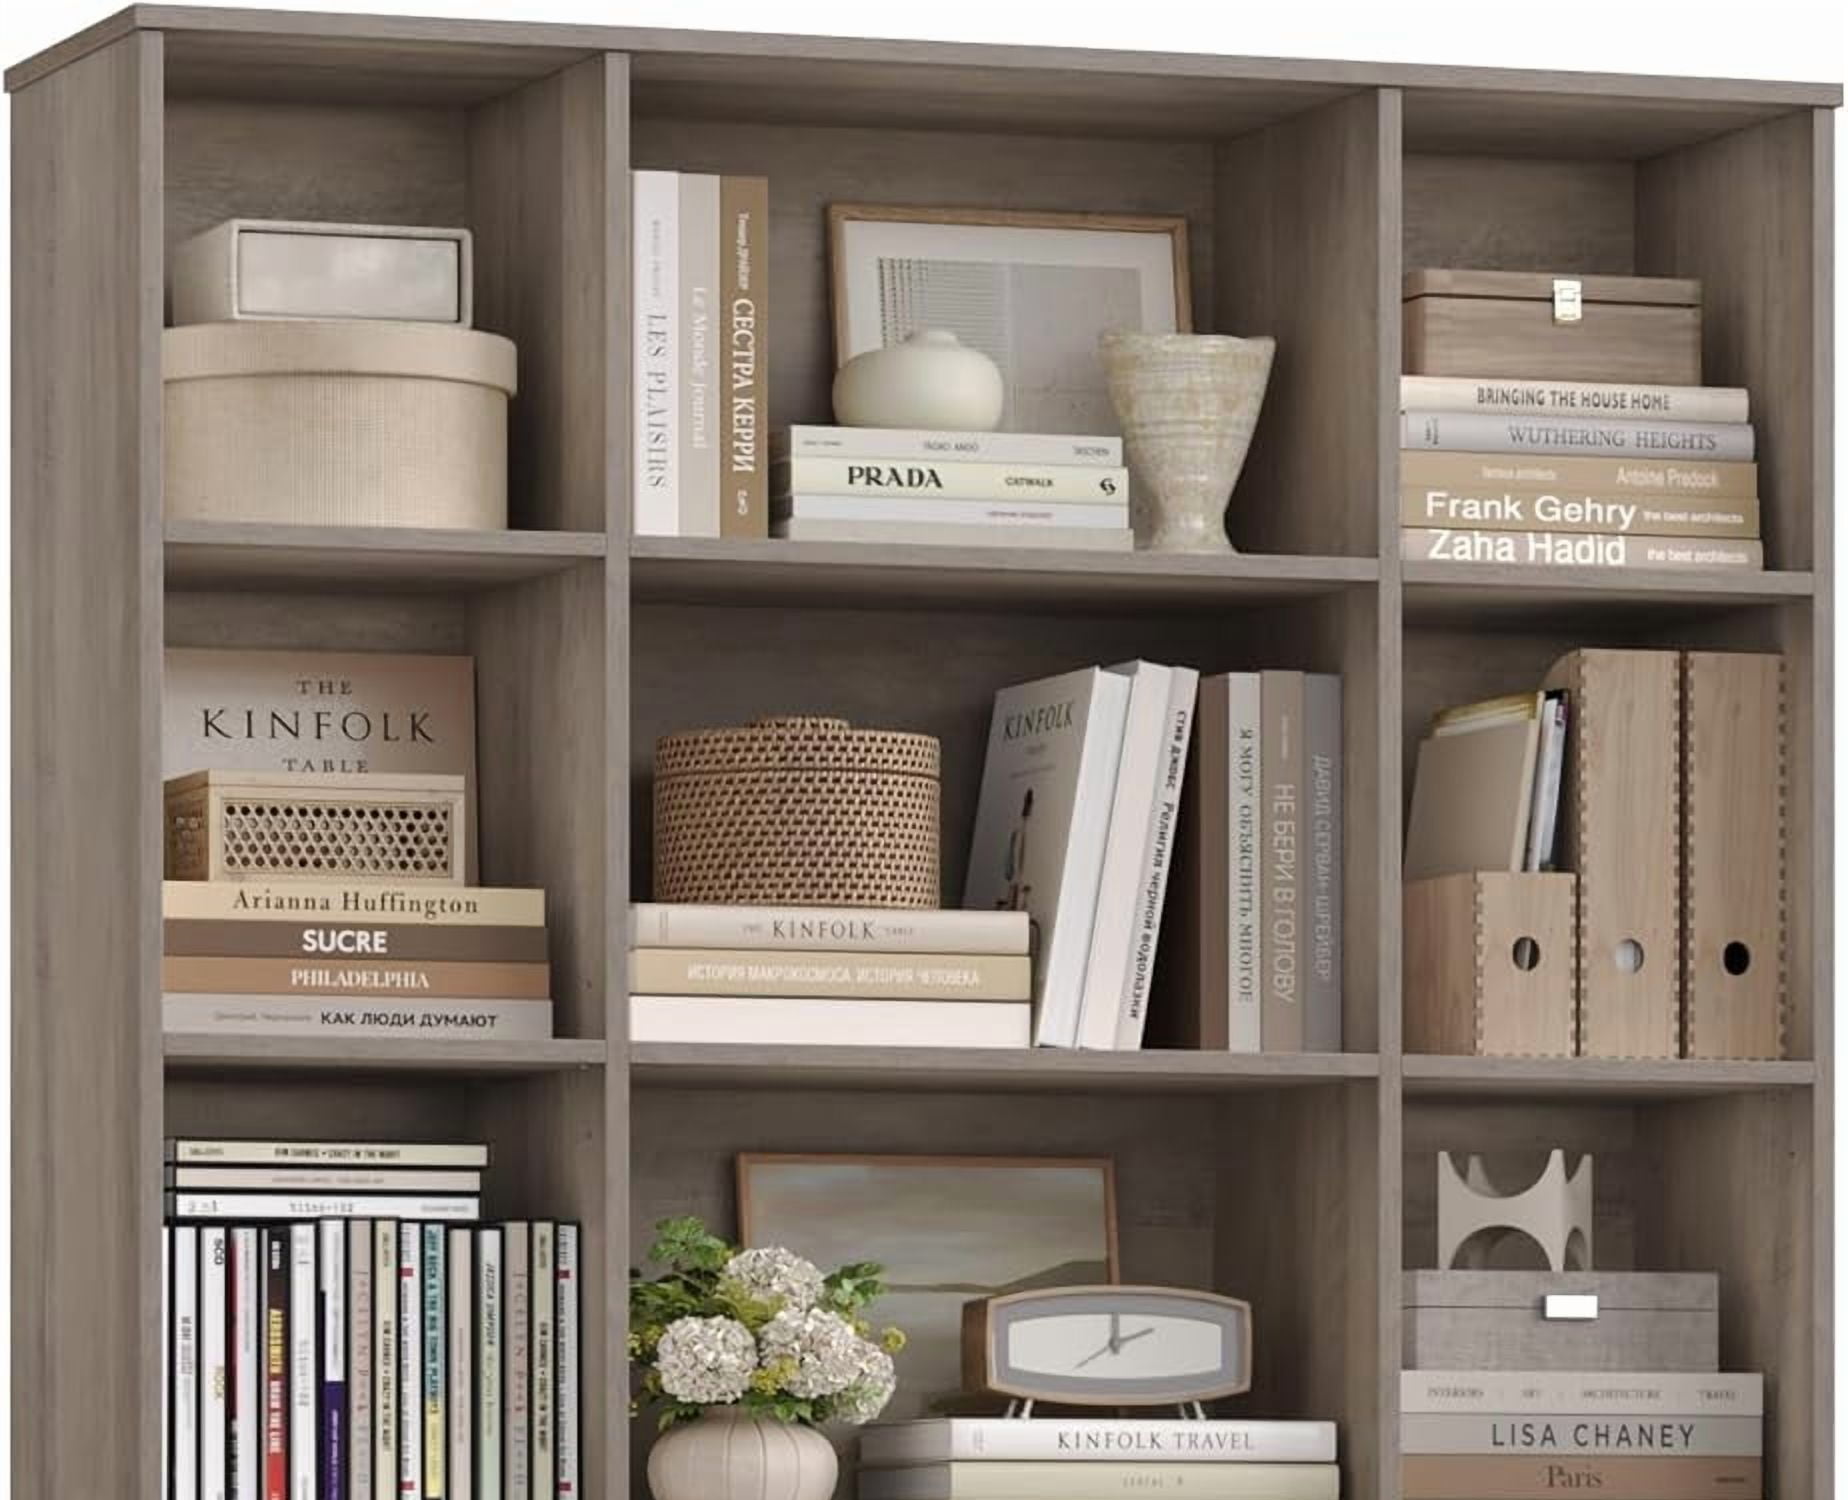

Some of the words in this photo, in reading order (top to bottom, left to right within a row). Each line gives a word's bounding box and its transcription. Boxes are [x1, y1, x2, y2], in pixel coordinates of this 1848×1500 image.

[647, 314, 667, 357] LES
[732, 298, 755, 391] СЕСТРА
[1476, 386, 1546, 406] BRINGING
[1550, 389, 1577, 408] THE
[1580, 391, 1627, 409] HOUSE
[1630, 393, 1671, 411] HOME
[647, 371, 667, 487] PLAISIRS
[732, 396, 755, 473] КЕРРИ
[1507, 425, 1625, 447] WUTHERING
[1635, 430, 1717, 450] HEIGHTS
[847, 465, 943, 489] PRADA
[1426, 491, 1524, 522] Frank
[1534, 493, 1637, 531] Gehry
[1427, 529, 1515, 562] Zaha
[1528, 531, 1627, 566] Hadid
[296, 679, 354, 696] THE
[202, 707, 436, 743] KINFOLK
[1003, 702, 1073, 741] KINFOLK
[282, 757, 370, 774] TABLE
[1239, 746, 1253, 797] МОГУ
[1273, 784, 1296, 814] НЕ
[1273, 820, 1296, 882] БЕРИ
[232, 889, 332, 912] Arianna
[342, 891, 479, 919] Huffington
[1273, 887, 1296, 903] В
[302, 929, 388, 954] SUCRE
[772, 918, 875, 941] KINFOLK
[1239, 924, 1253, 1003] МНОГОЕ
[1273, 908, 1296, 1003] ГОЛОВУ
[290, 968, 430, 990] PHILADELPHIA
[320, 1011, 354, 1025] КАК
[360, 1012, 415, 1028] ЛЮДИ
[419, 1013, 497, 1029] ДУМАЮТ
[1057, 1430, 1163, 1451] KINFOLK
[1172, 1431, 1254, 1451] TRAVEL
[1491, 1422, 1557, 1448] LISA
[1572, 1423, 1696, 1449] CHANEY
[1543, 1464, 1603, 1490] Paris
